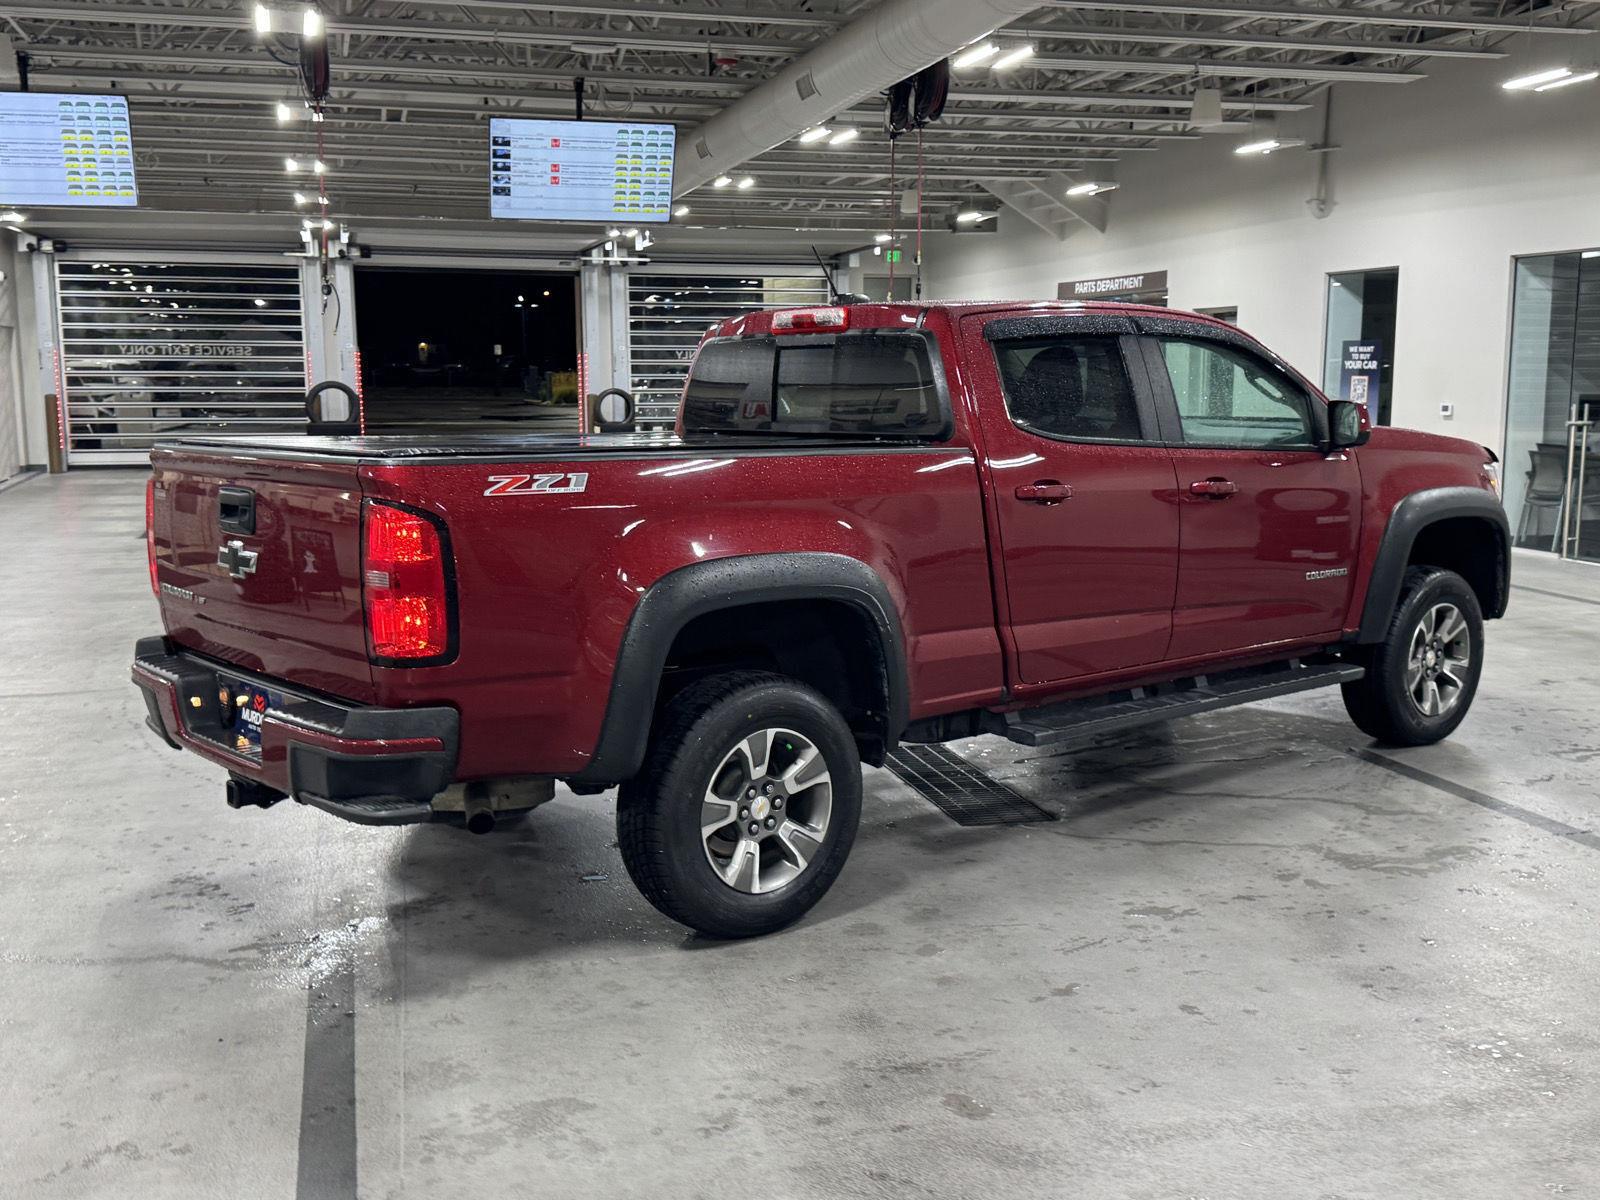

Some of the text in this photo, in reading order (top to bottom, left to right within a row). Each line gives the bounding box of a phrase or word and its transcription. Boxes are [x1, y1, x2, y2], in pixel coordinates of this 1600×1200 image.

[1074, 276, 1144, 294] PARTS DEPARTMENT
[1344, 361, 1378, 369] YOUR CAR
[483, 473, 589, 496] Z71
[1305, 567, 1348, 580] COLORADO
